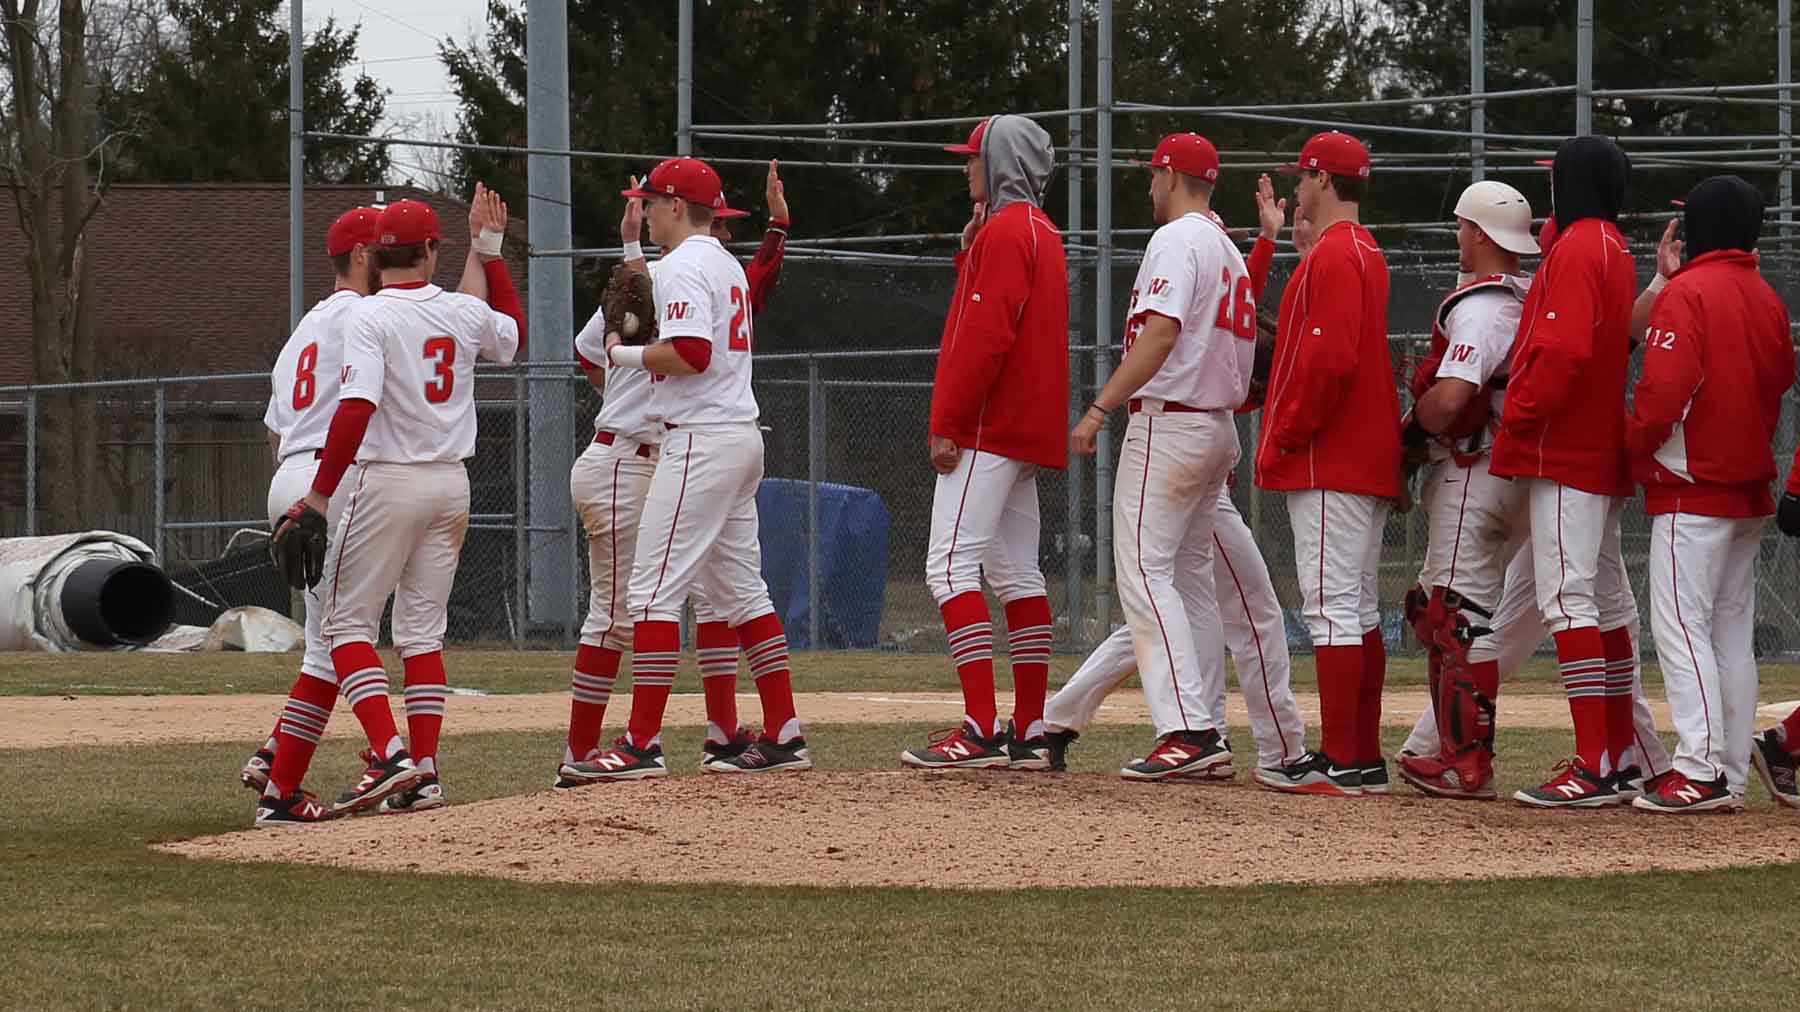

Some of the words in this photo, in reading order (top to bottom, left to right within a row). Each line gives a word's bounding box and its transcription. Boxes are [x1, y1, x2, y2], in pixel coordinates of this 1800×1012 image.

[728, 286, 753, 352] 2
[1214, 266, 1257, 340] 26
[293, 341, 318, 411] 8
[424, 336, 456, 404] 3
